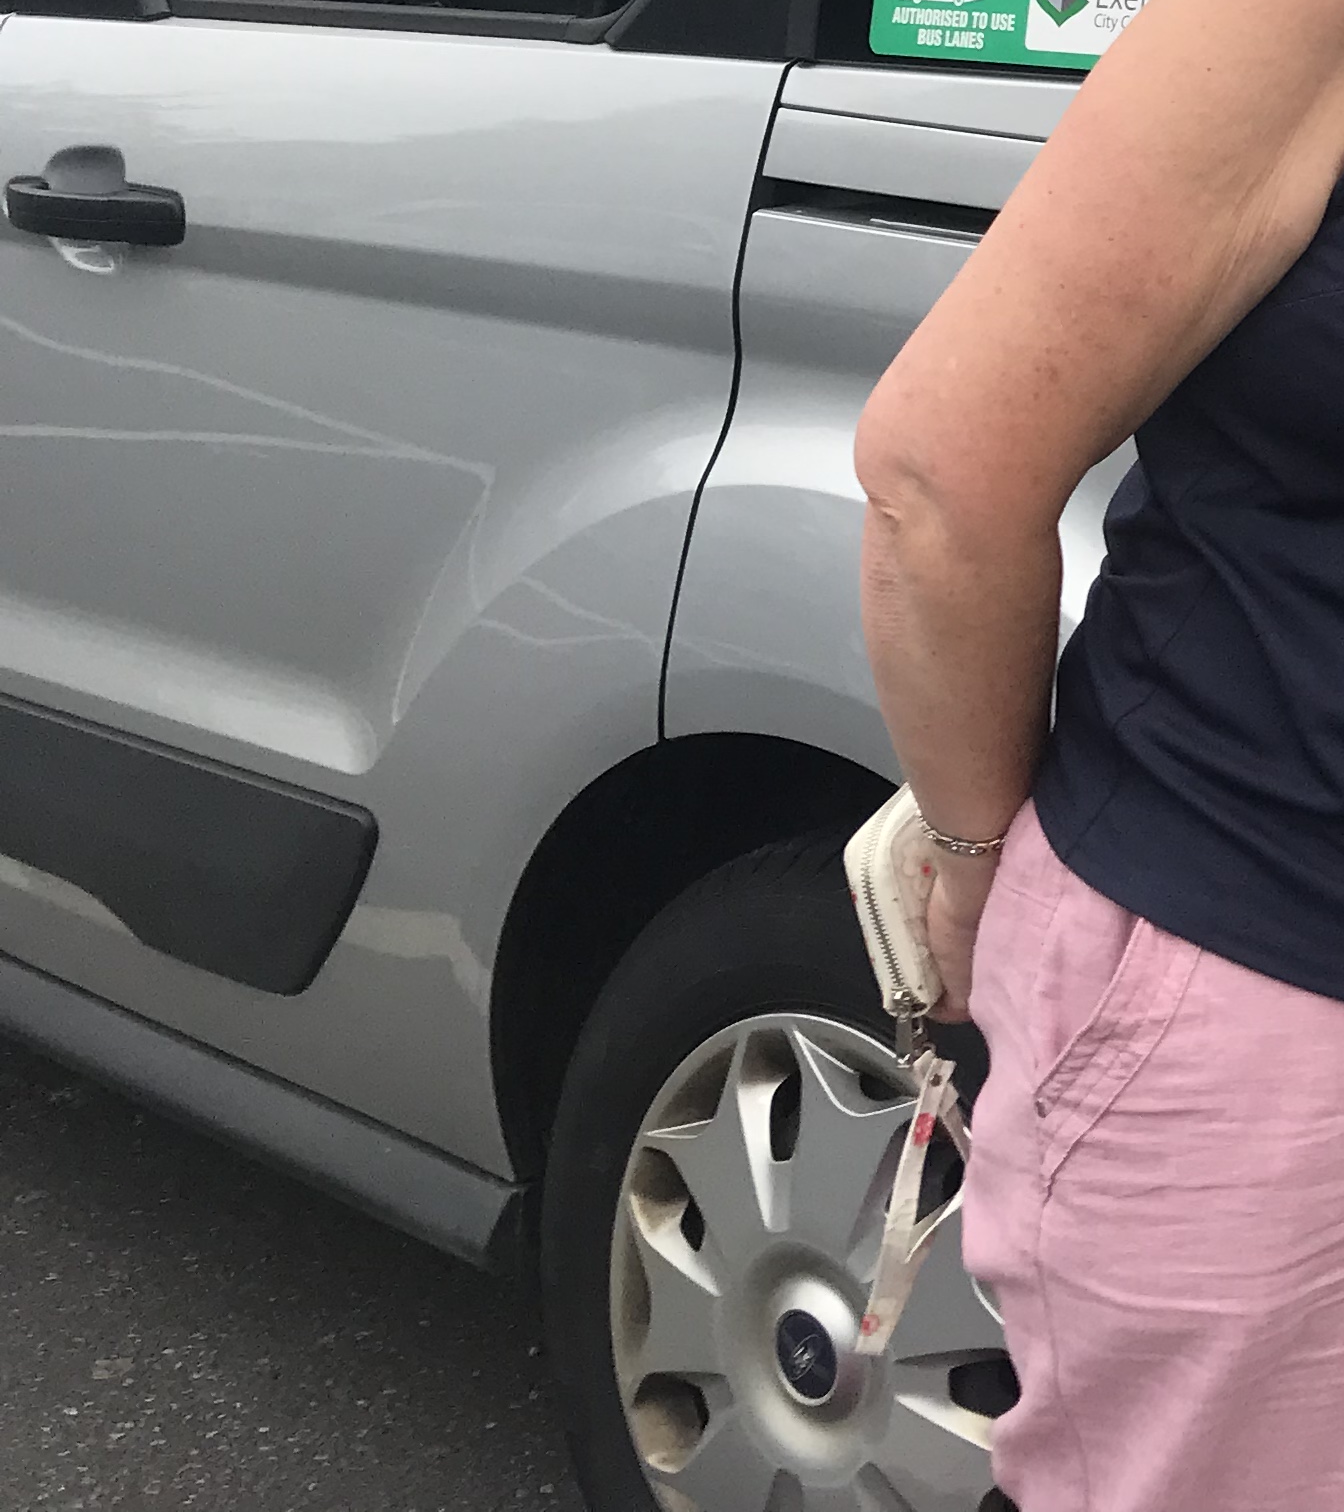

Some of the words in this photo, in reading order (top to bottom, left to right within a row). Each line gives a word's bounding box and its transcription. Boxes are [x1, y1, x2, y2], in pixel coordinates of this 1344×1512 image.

[891, 7, 968, 29] AUTHORISED
[971, 11, 988, 30] TO
[990, 13, 1016, 32] USE
[1094, 13, 1119, 32] City
[917, 29, 942, 47] BUS
[944, 31, 985, 50] LANES
